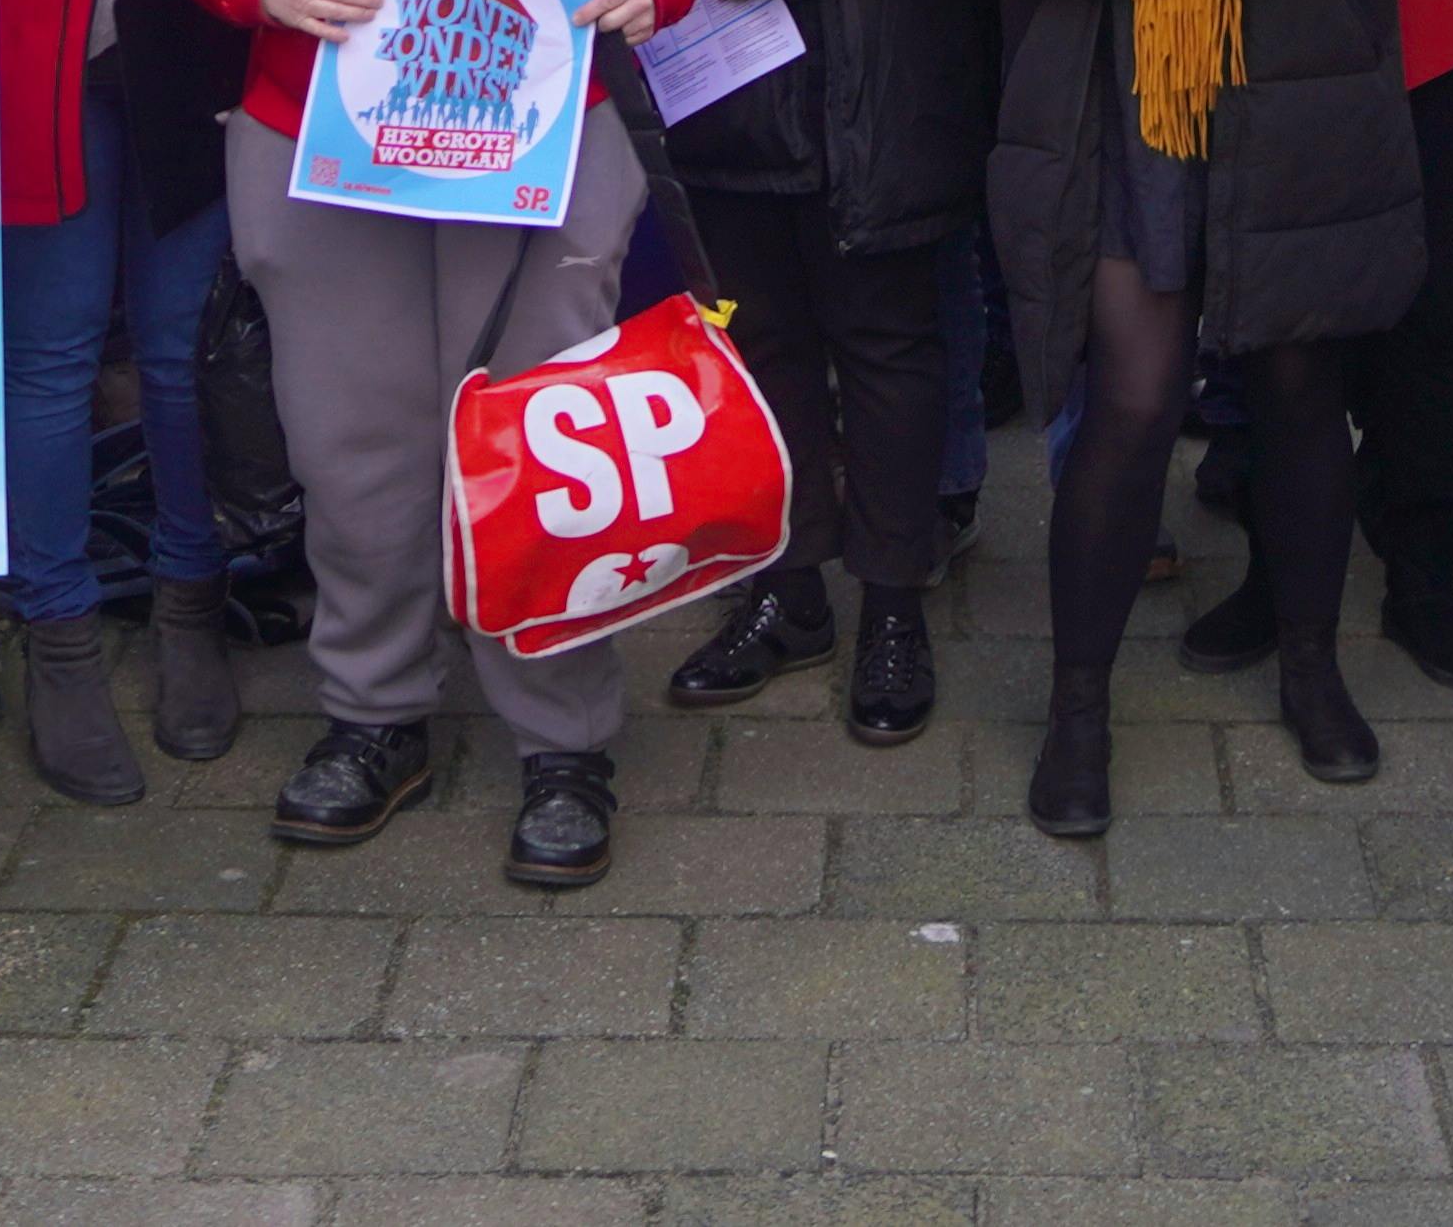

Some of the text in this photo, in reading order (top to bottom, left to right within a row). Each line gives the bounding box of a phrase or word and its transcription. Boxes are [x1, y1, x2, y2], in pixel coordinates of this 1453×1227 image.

[377, 25, 531, 76] ZONDER
[399, 62, 527, 102] WINST
[379, 129, 511, 152] HET GROTE
[377, 147, 511, 170] WOONPLAN
[513, 186, 550, 212] SP.
[524, 371, 705, 538] SP
